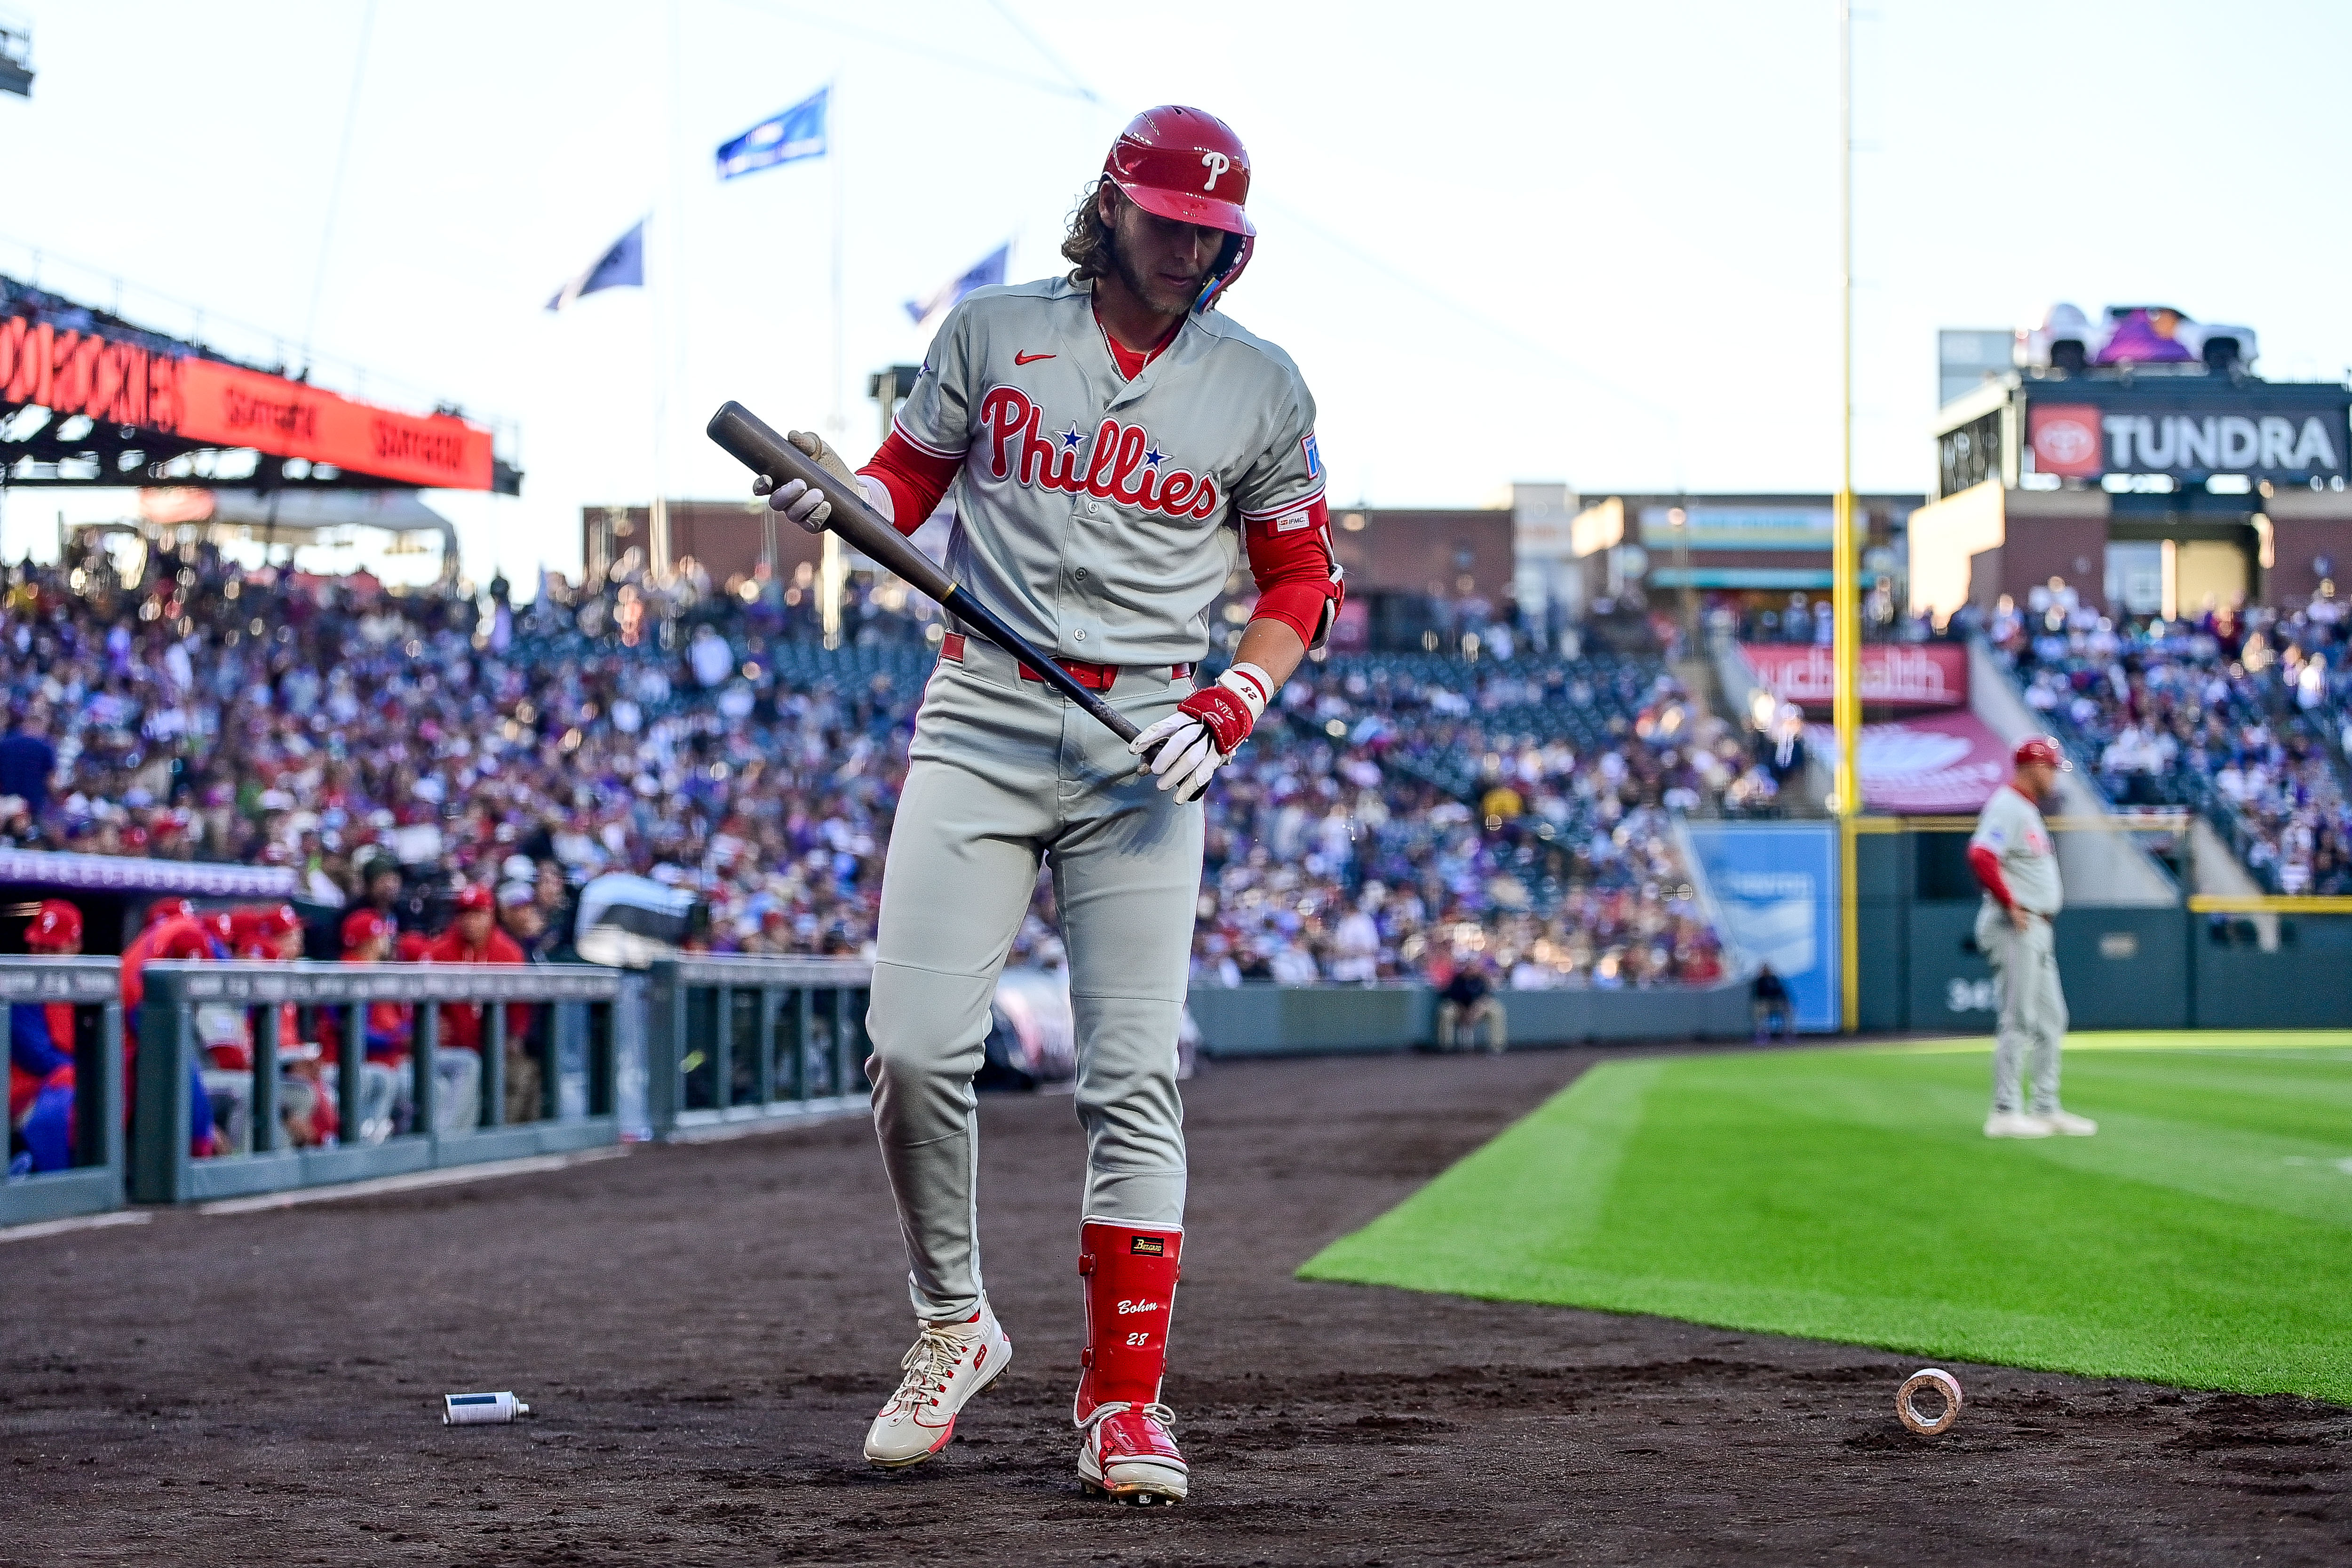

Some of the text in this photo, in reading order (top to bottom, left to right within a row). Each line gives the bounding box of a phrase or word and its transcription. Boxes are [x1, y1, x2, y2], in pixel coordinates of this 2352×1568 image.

[1202, 151, 1230, 191] P
[980, 385, 1219, 521] Phillies
[2102, 414, 2339, 470] TUNDRA
[1240, 686, 1257, 700] 28
[1117, 1298, 1158, 1314] Bohm
[1126, 1332, 1149, 1346] 28
